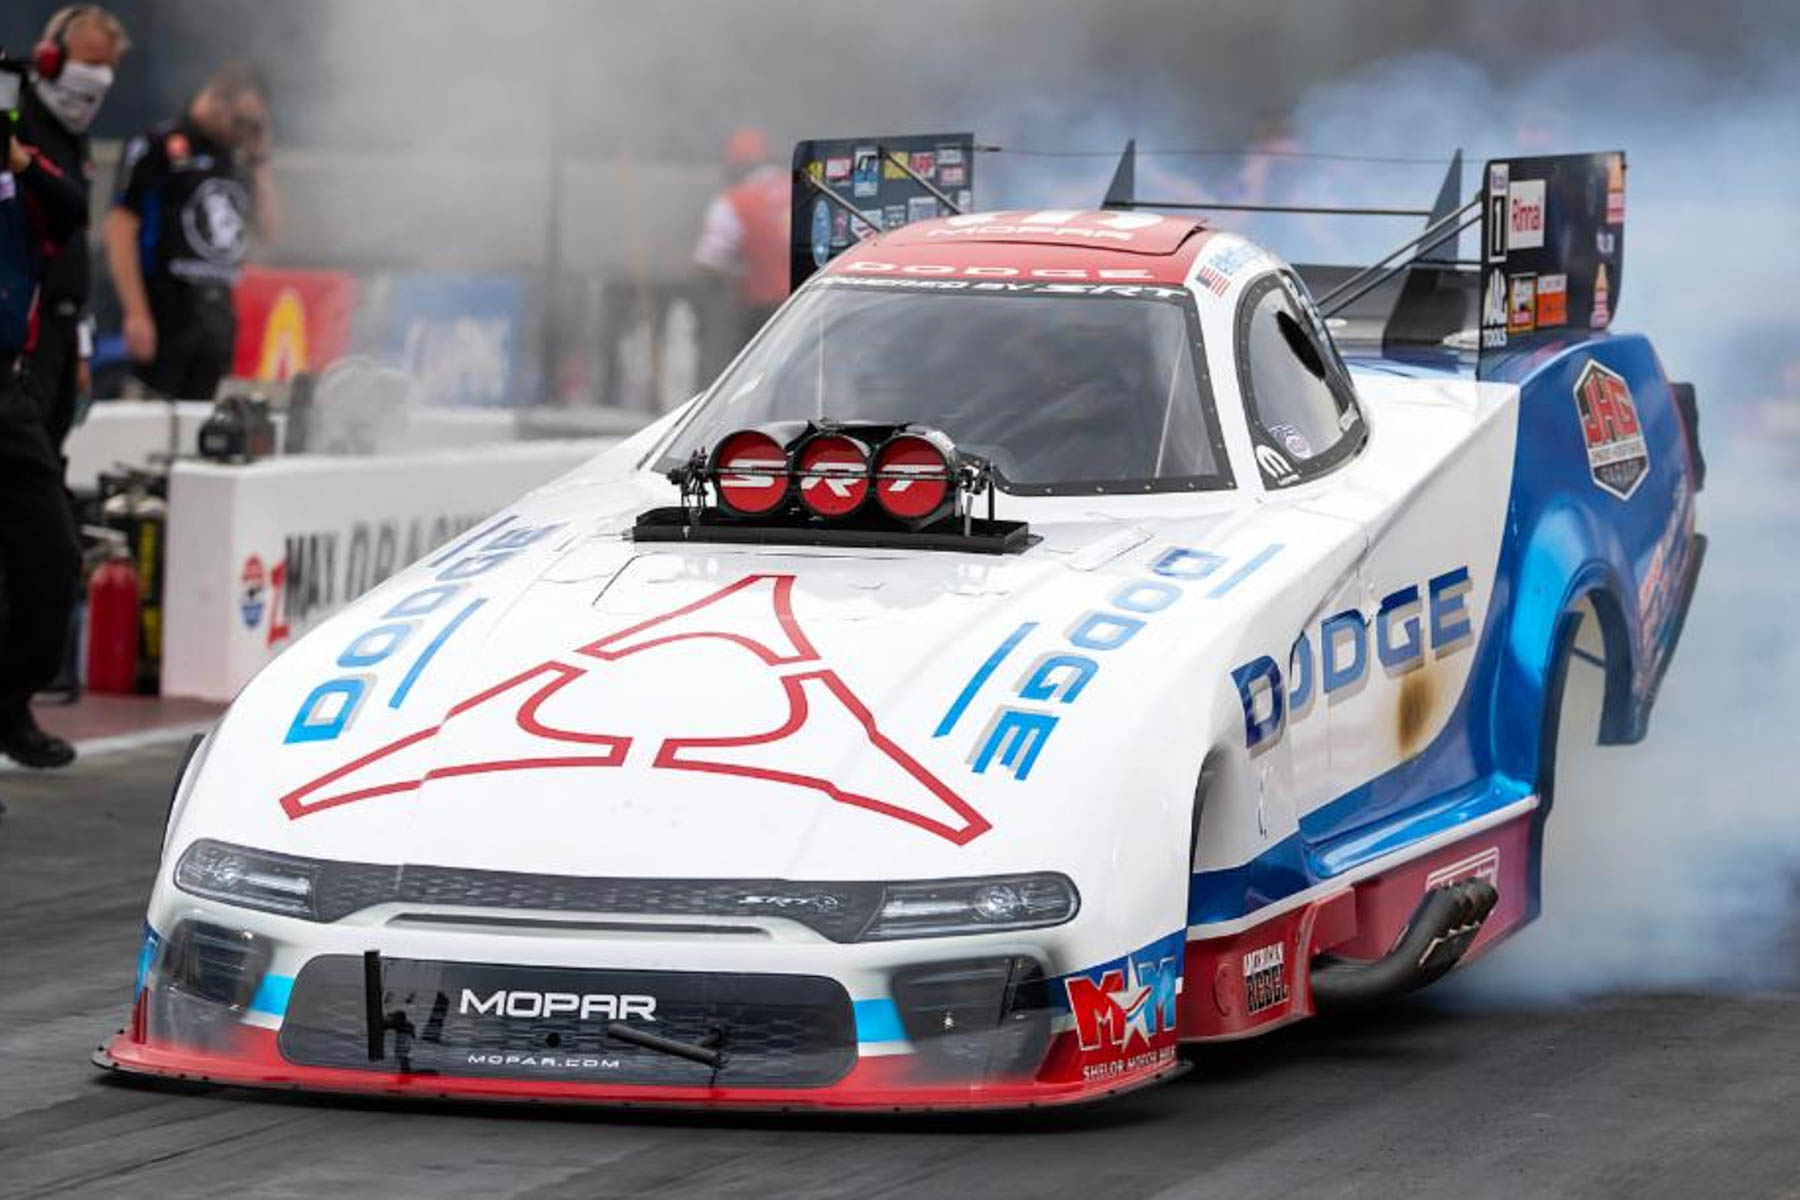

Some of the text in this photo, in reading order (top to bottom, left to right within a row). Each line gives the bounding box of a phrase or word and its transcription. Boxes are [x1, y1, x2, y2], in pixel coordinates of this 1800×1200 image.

[927, 224, 1135, 241] MOPAR
[847, 261, 1156, 280] DODGE
[1034, 282, 1190, 298] SRT
[719, 457, 946, 498] SRT
[284, 521, 568, 745] DODGE
[968, 547, 1228, 782] DODGE
[459, 988, 657, 1022] MOPAR
[467, 1054, 620, 1069] MOPAR.COM
